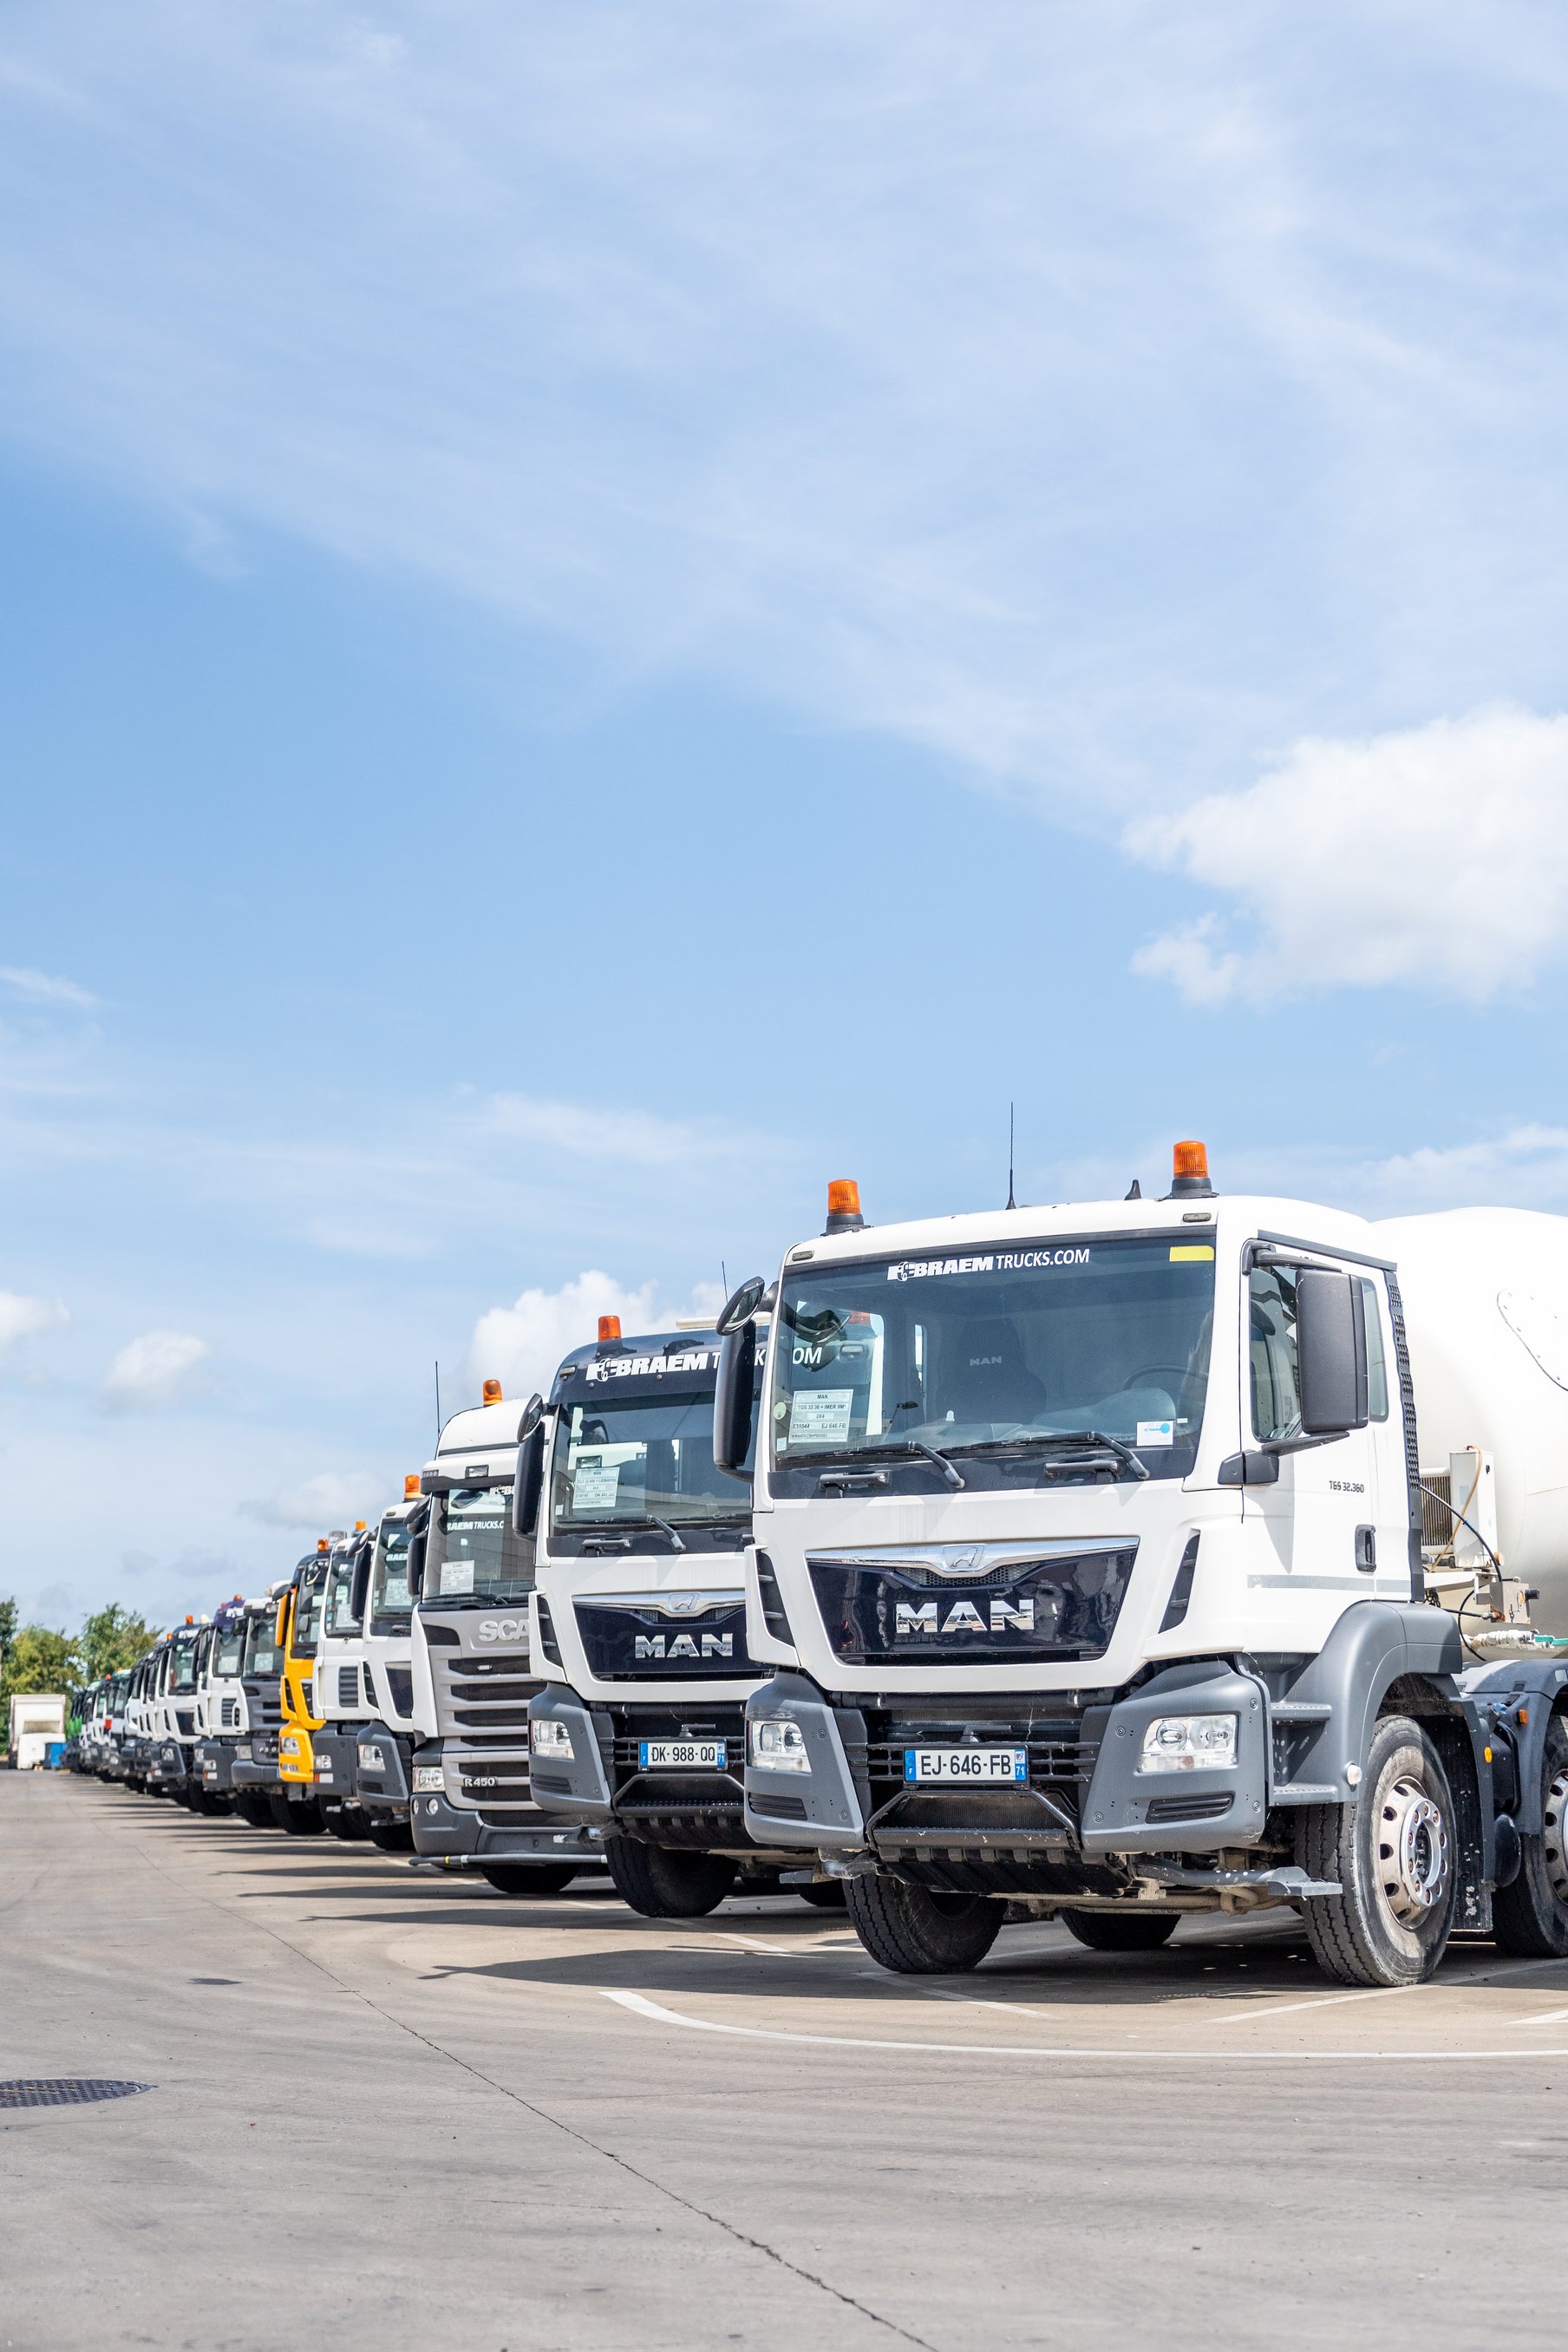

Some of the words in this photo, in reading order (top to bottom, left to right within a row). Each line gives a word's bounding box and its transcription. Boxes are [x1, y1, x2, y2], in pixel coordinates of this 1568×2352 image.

[970, 1356, 1003, 1367] MAN
[1343, 1481, 1365, 1493] 32.360
[896, 1598, 1035, 1634] MAN
[479, 1619, 530, 1643] SCA
[635, 1632, 734, 1659] MAN
[651, 1746, 715, 1762] DK-988-QQ
[717, 1754, 725, 1763] 71
[920, 1754, 1011, 1775] EJ-646-FB
[1016, 1766, 1025, 1776] 71
